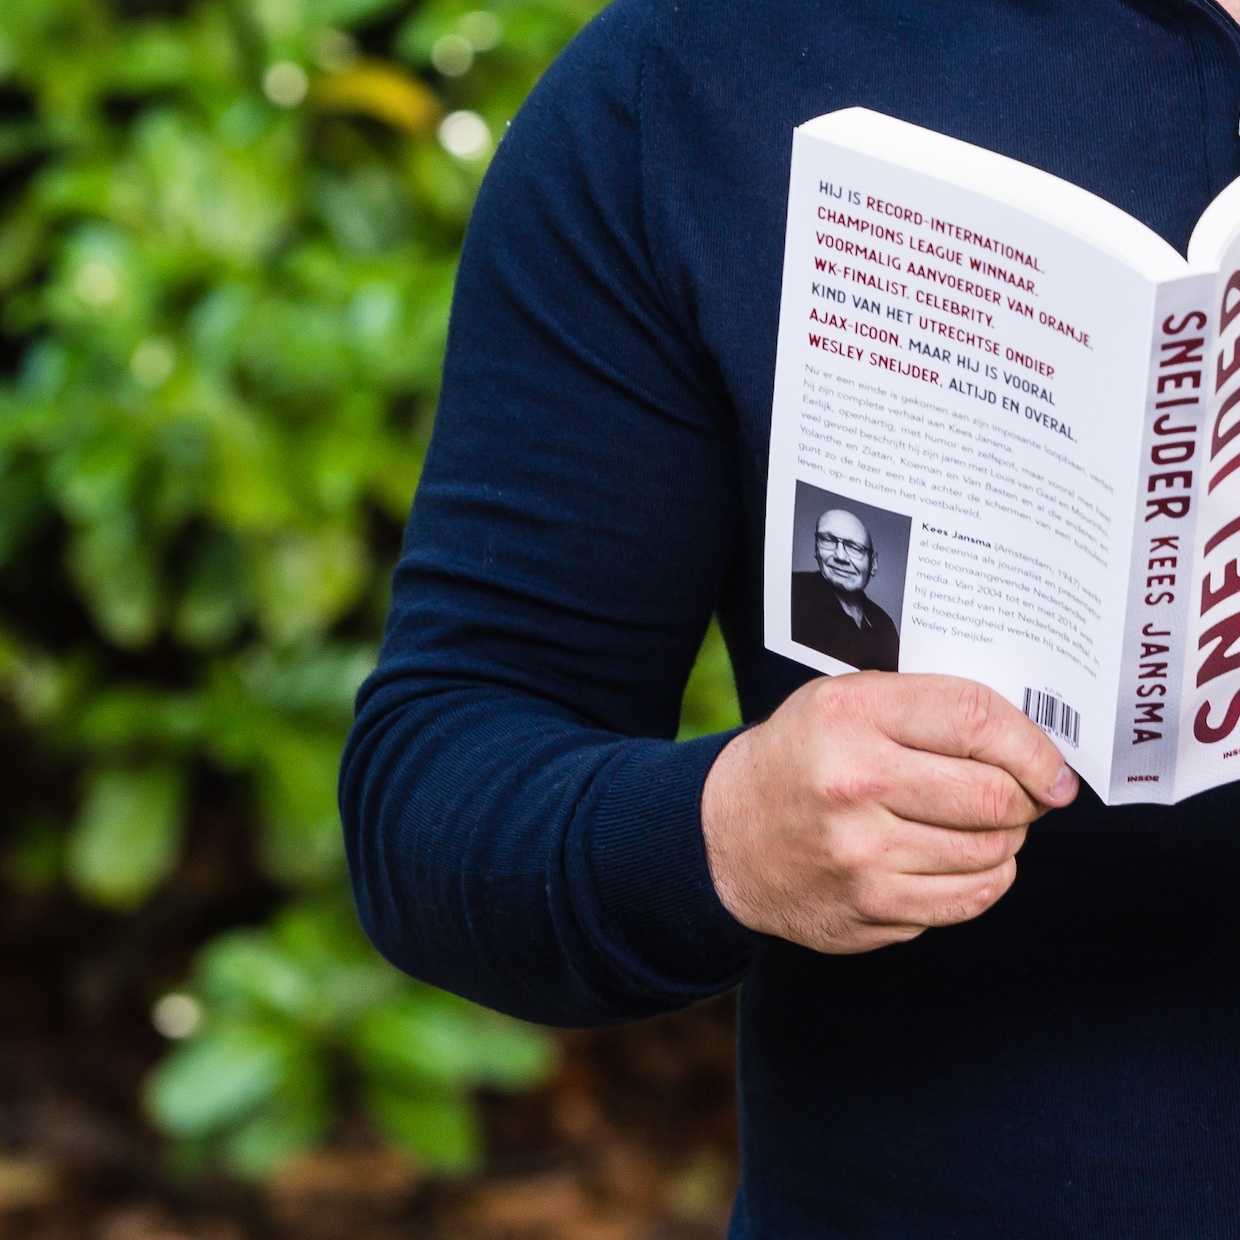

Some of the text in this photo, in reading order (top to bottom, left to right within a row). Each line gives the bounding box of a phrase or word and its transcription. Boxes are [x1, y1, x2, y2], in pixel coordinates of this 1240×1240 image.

[818, 206, 1038, 297] CHAMPIONS LEAGUE WINNAAR.
[820, 180, 1044, 274] HIJ IS RECORD-INTERNATIONAL.
[812, 282, 1055, 380] KIND VAN HET UTRECHTSE ONDIEP.
[815, 257, 995, 329] WK-FINALIST. CELEBRITY.
[816, 231, 1093, 351] VOORMALIG AANVOERDER VAN ORANJE.
[809, 333, 864, 362] WESLEY
[949, 377, 997, 404] ALTIJD
[1002, 396, 1020, 414] EN
[1025, 406, 1078, 444] OVERAL.
[810, 308, 1056, 407] AJAX-ICOON. MAAR HIJ IS VOORAL
[802, 394, 835, 413] Eerlijk,
[838, 408, 896, 433] openhartig,
[901, 426, 921, 438] met
[925, 432, 957, 449] humor
[961, 446, 973, 455] en
[977, 450, 1018, 472] zelfspot,
[1021, 467, 1045, 481] maar
[1047, 479, 1076, 498] vooral
[803, 379, 1014, 455] hij zijn complete verhaal aan Kees Jansma.
[805, 363, 820, 376] Nu
[823, 371, 833, 379] er
[836, 376, 855, 386] een
[859, 382, 887, 396] einde
[890, 391, 898, 400] is
[901, 395, 949, 415] gekomen
[951, 410, 970, 422] aan
[972, 418, 989, 429] zijn
[992, 424, 1041, 450] imposante
[797, 455, 982, 520] leven, op- en buiten het voetbalveld.
[798, 442, 821, 456] gunt
[824, 451, 837, 461] zo
[840, 456, 854, 466] de
[858, 460, 882, 474] lezer
[885, 471, 905, 481] een
[908, 475, 927, 488] blik
[931, 483, 964, 498] achter
[967, 493, 981, 503] de
[984, 499, 1032, 523] schermen
[1035, 519, 1052, 531] van
[1054, 529, 1071, 542] een
[800, 424, 842, 446] Yolanthe
[845, 442, 858, 451] en
[862, 445, 895, 464] Zlatan,
[900, 457, 942, 475] Koeman
[946, 471, 959, 481] en
[962, 474, 981, 488] Van
[985, 482, 1018, 501] Basten
[1021, 498, 1034, 508] en
[1036, 503, 1045, 513] al
[1047, 509, 1062, 521] die
[801, 411, 822, 424] veel
[824, 419, 858, 434] gevoel
[860, 429, 906, 450] beschrijft
[908, 443, 920, 457] hij
[923, 448, 939, 460] zijn
[941, 454, 966, 468] jaren
[968, 463, 988, 475] met
[990, 469, 1015, 485] Louis
[1017, 480, 1034, 492] van
[1036, 487, 1057, 503] Gaal
[1059, 500, 1070, 510] en
[920, 539, 929, 548] al
[931, 541, 979, 561] decennia
[982, 556, 996, 566] als
[998, 560, 1043, 584] journalist
[1045, 579, 1056, 590] en
[922, 522, 949, 537] Kees
[951, 531, 992, 548] Jansma
[994, 542, 1055, 575] (Amsterdam,
[1058, 568, 1081, 590] 1947)
[1132, 311, 1207, 745] SNEIJDER KEES JANSMA
[911, 615, 996, 645] Wesley Sneijder.
[913, 600, 929, 613] die
[932, 605, 1005, 631] hoedanigheid
[1006, 626, 1041, 643] werkte
[1042, 636, 1054, 652] hij
[1056, 645, 1082, 667] samen
[914, 584, 927, 598] hij
[929, 590, 974, 608] perschef
[977, 602, 995, 613] van
[998, 606, 1015, 619] het
[1017, 612, 1071, 643] Nederlands
[916, 571, 1093, 646] media. Van 2004 tot en met 2014 was
[917, 555, 1087, 625] voor toonaangevende Nederlandse
